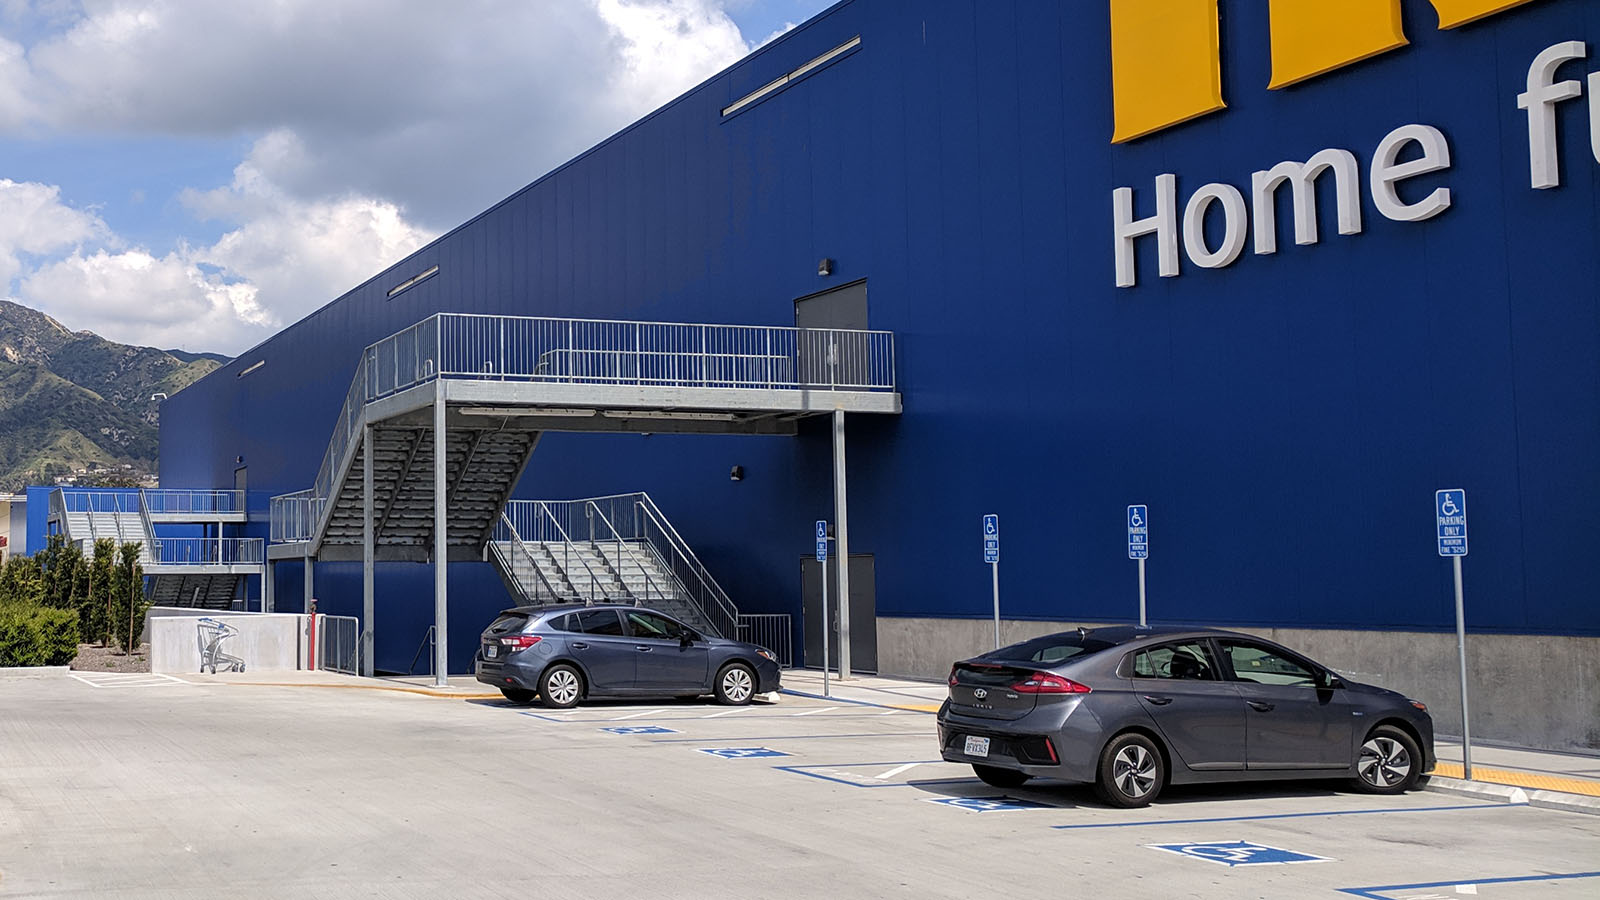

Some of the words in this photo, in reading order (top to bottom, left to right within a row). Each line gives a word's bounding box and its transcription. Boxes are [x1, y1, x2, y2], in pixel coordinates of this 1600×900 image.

[1113, 124, 1451, 288] Home
[1517, 41, 1600, 189] f
[1439, 516, 1464, 526] PARKING
[1444, 526, 1460, 536] ONLY
